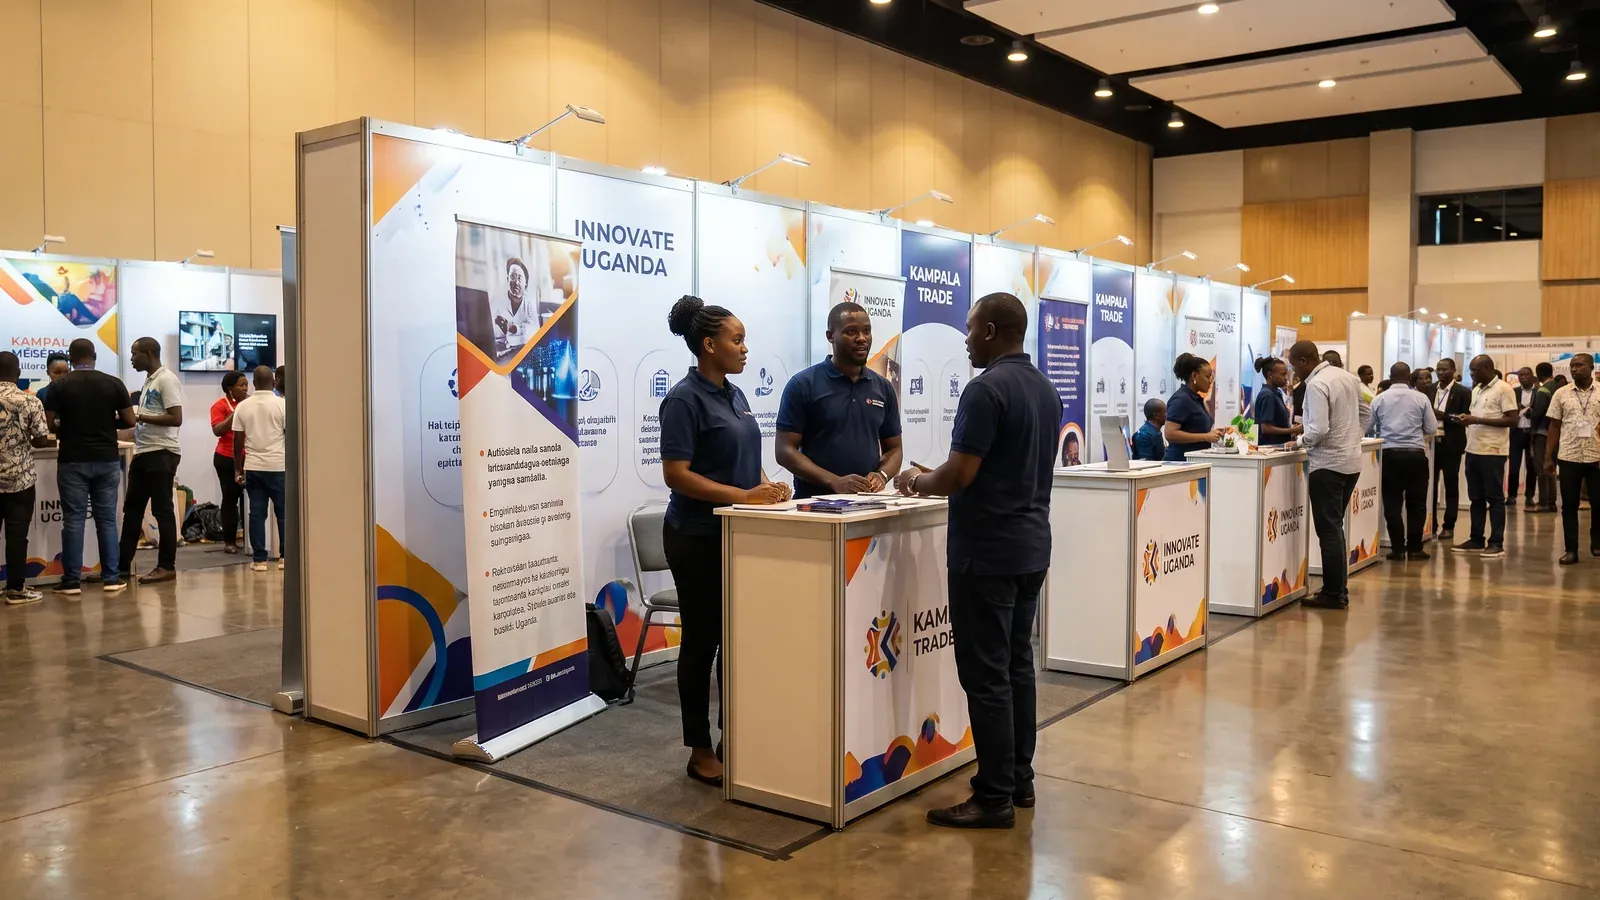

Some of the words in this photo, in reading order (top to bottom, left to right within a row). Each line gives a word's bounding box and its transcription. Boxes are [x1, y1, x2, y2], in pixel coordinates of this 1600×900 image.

[575, 219, 674, 251] INNOVATE
[583, 248, 667, 277] UGANDA
[910, 265, 961, 286] KAMPALA
[864, 296, 896, 307] INNOVATE
[917, 287, 953, 305] TRADE
[1095, 293, 1128, 309] KAMPALA
[1100, 309, 1123, 323] TRADE
[11, 336, 75, 347] KAMPAL
[1164, 534, 1199, 557] INNOVATE
[1164, 553, 1194, 575] UGANDA
[914, 605, 951, 634] KAM
[913, 629, 955, 656] TRADE
